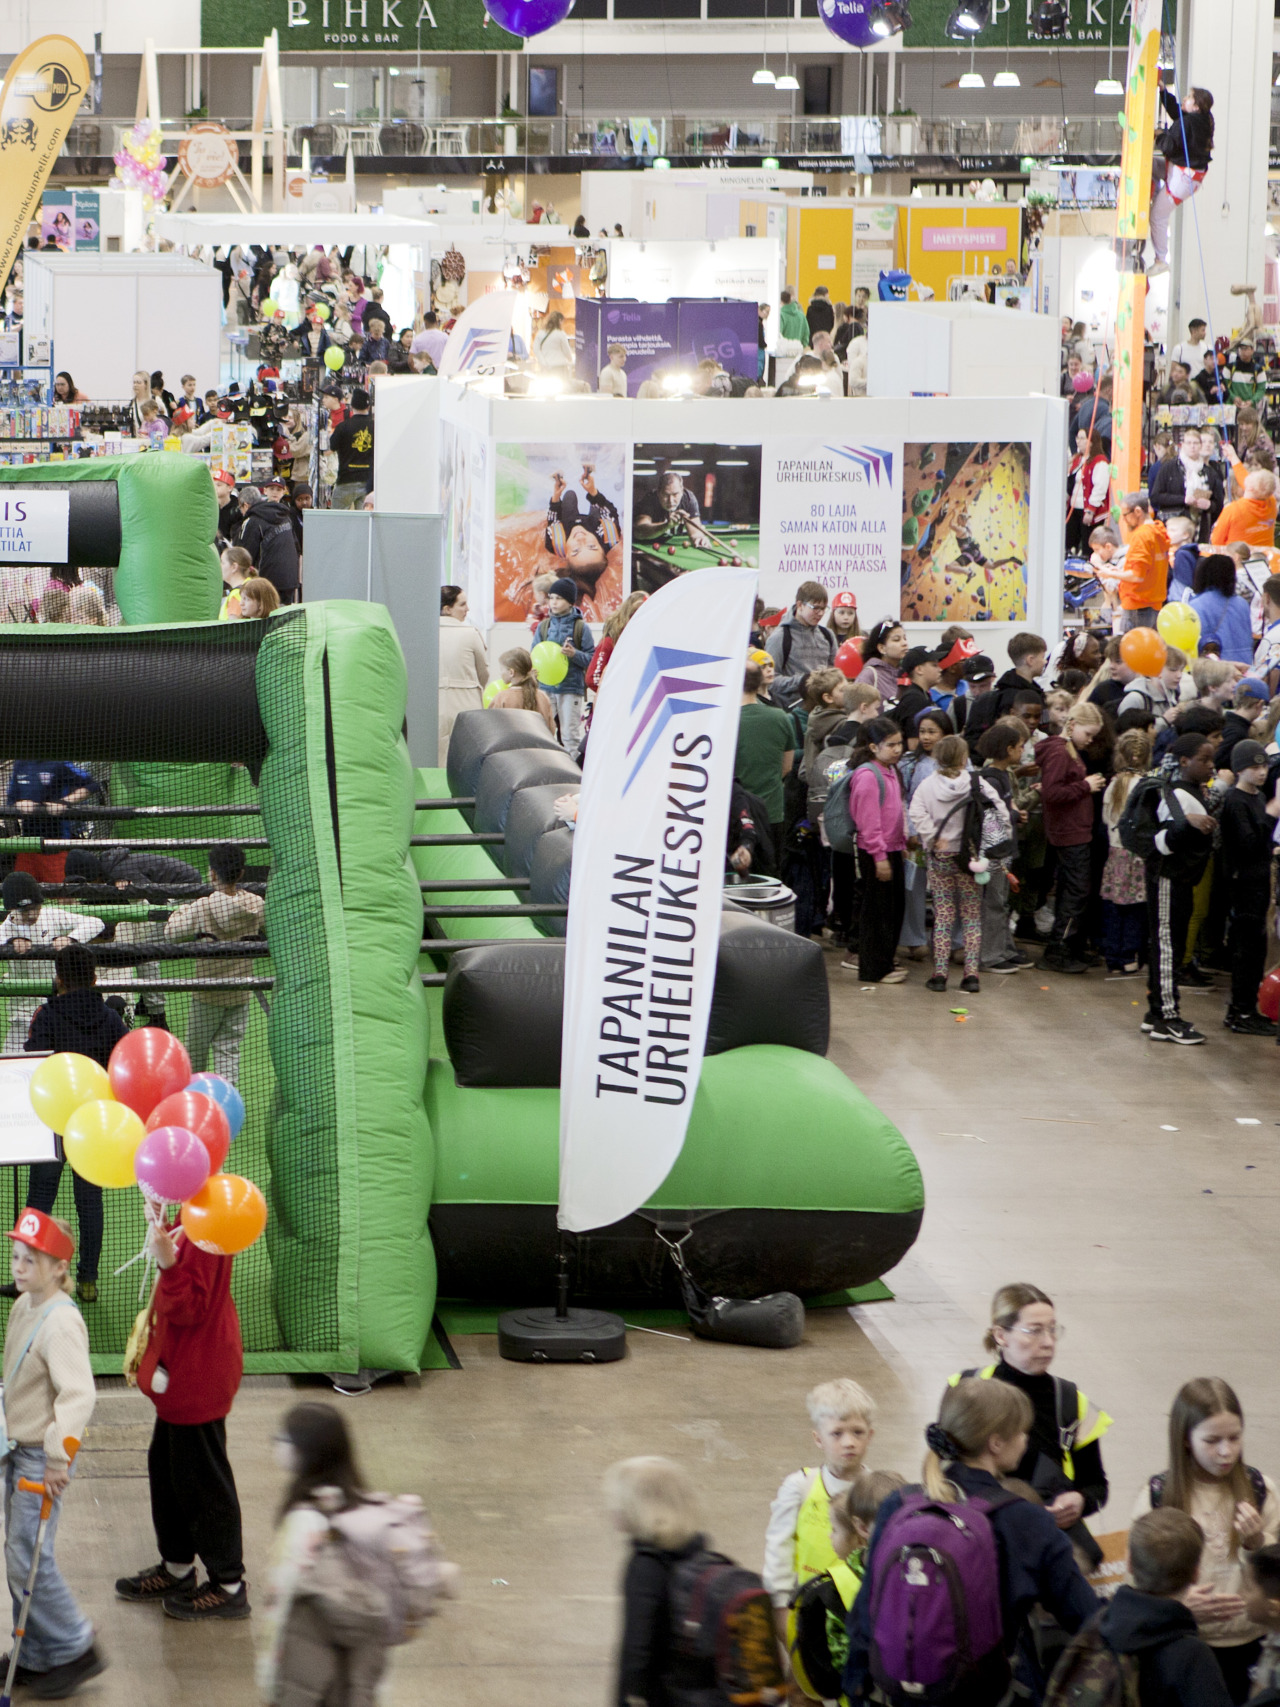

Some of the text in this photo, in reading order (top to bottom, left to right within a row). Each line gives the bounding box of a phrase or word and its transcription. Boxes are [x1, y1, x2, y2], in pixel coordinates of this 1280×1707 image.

[287, 0, 438, 28] PIHKA
[837, 2, 864, 14] Telia
[991, 0, 1132, 25] PIKA
[324, 33, 400, 43] FOOD & BAR
[1078, 30, 1102, 40] BAR
[932, 233, 996, 246] IMETYSPISTE
[622, 312, 641, 322] Telia
[703, 341, 735, 361] 5G
[777, 460, 833, 471] TAPANILAN
[776, 471, 863, 483] URHEILUKESKUS
[810, 504, 857, 517] 80 LAJIA
[780, 520, 887, 534] SAMAN KATON ALLA
[784, 543, 883, 556] VAIN 13 MINUUTIN
[778, 556, 888, 573] AJOMATKAN PÄÄSSÄ
[816, 572, 849, 589] TÄSTÄ
[644, 732, 713, 1106] URHEILUKESKUS
[596, 853, 655, 1099] TAPANILAN
